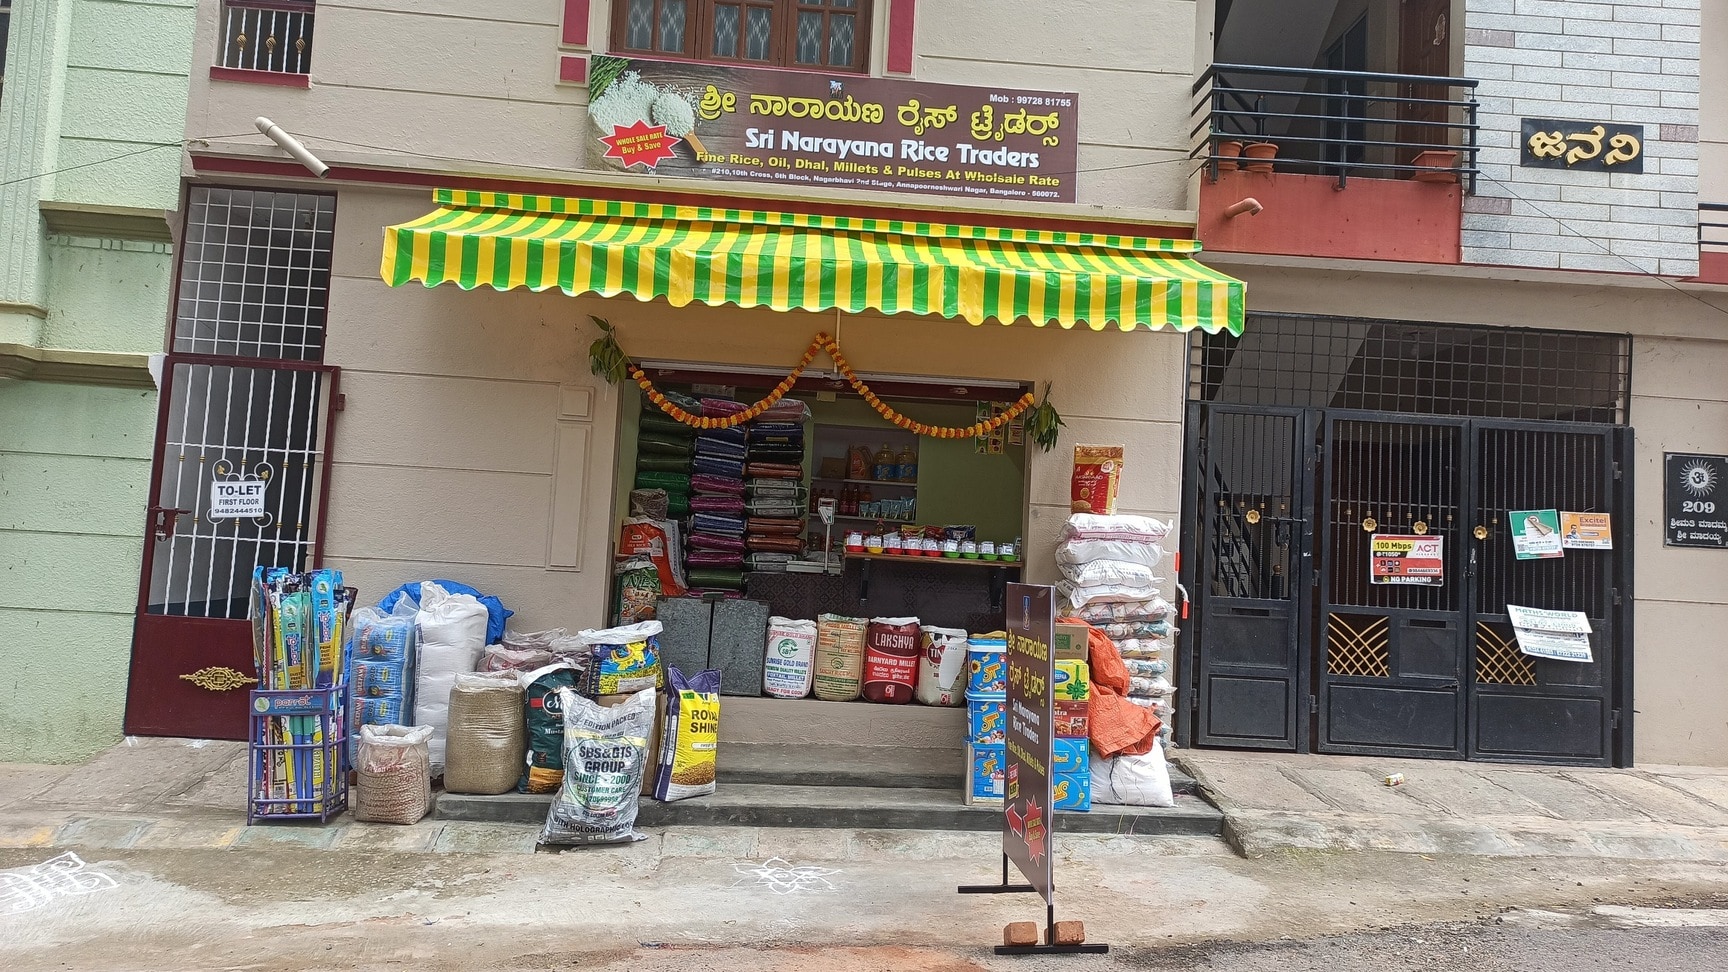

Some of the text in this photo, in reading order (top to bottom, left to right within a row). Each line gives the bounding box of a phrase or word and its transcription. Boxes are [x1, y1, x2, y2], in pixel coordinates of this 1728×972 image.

[989, 94, 1009, 104] Mob
[1016, 96, 1043, 106] 99728
[1045, 97, 1072, 107] 81755
[699, 84, 736, 120] ಶ್ರೀ
[750, 94, 885, 124] ನಾರಾಯಣ
[897, 99, 958, 136] ರೈಸ್
[615, 131, 663, 147] WHOLE SALE RATE
[621, 141, 662, 155] Buy & Save
[745, 127, 1040, 168] Sri Narayana Rice Traders
[696, 151, 725, 163] Fine
[730, 153, 764, 168] Rice,
[768, 156, 791, 170] Oil,
[795, 158, 829, 172] Dhal,
[834, 161, 879, 175] Millets
[883, 165, 893, 176] &
[897, 166, 942, 179] Pulses
[945, 170, 961, 181] At
[1029, 175, 1060, 187] Rate
[750, 170, 773, 180] Cross,
[788, 173, 812, 182] Block,
[813, 175, 855, 186] Nagarbhavi
[964, 186, 989, 195] Nagar,
[990, 188, 1026, 197] Bangalore
[217, 485, 262, 496] TO-LET
[218, 498, 260, 506] FIRST FLOOR
[1682, 500, 1716, 514] 209
[1376, 542, 1412, 551] 100 Mbps
[1416, 544, 1439, 553] ACT
[875, 632, 915, 650] LAKSHYA
[783, 659, 795, 667] GOLD
[868, 655, 916, 668] BARNYARD MILLET
[274, 694, 312, 709] parrot
[691, 709, 718, 721] ROYAL
[1018, 699, 1040, 727] Narayana
[583, 712, 636, 731] EDITION PACKED
[690, 722, 717, 734] SHINE
[1022, 721, 1040, 745] Traders
[579, 745, 632, 760] SBS&GTS
[584, 760, 626, 773] GROUP
[574, 771, 601, 784] SINCE
[610, 774, 631, 785] 2000
[576, 784, 626, 794] CUSTOMER CARE
